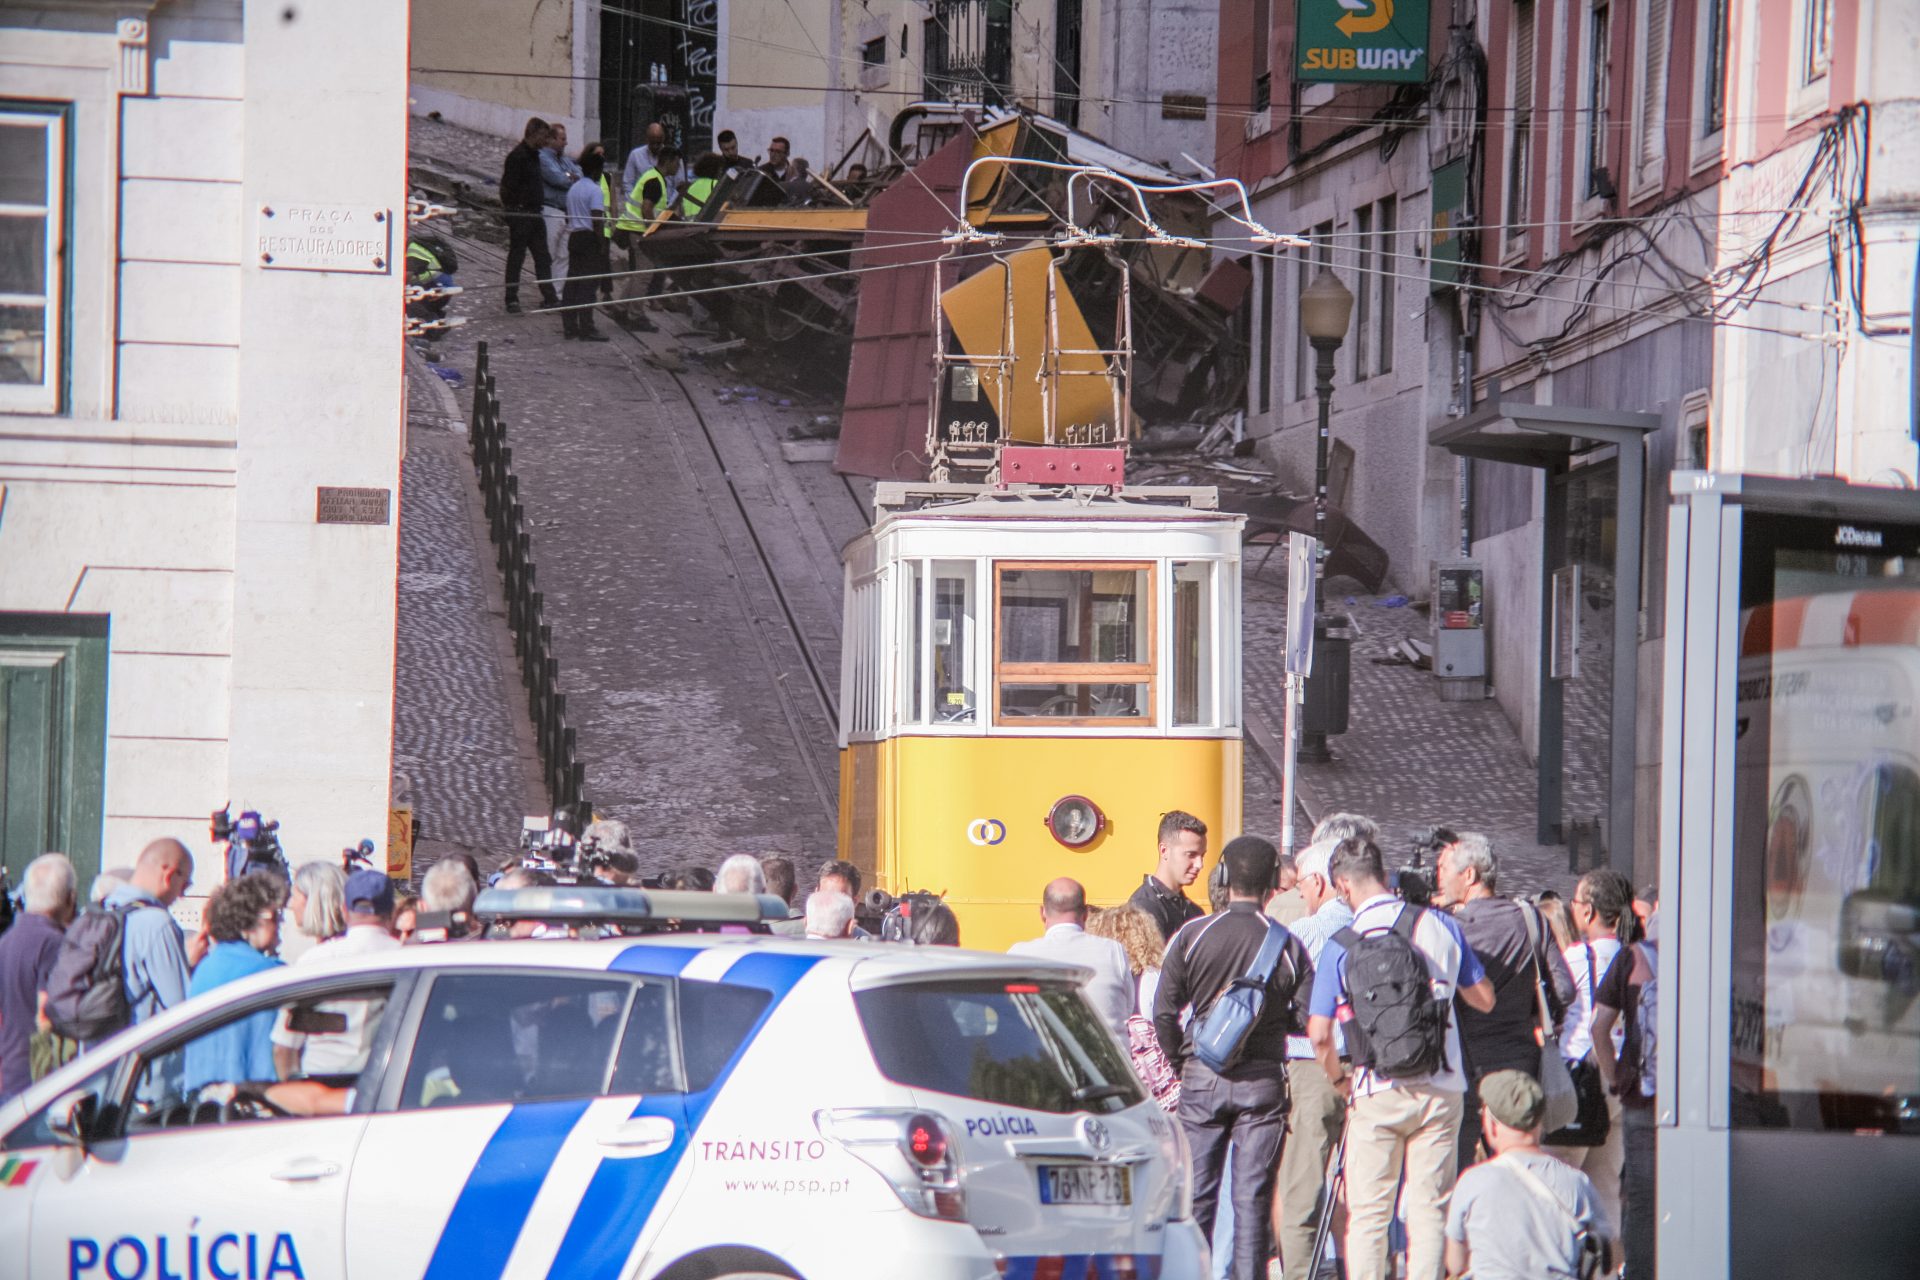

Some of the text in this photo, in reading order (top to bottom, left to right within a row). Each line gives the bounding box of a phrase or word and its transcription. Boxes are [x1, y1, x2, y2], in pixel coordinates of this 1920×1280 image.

[1302, 48, 1423, 70] SUBWAY
[289, 208, 354, 225] PRAÇA
[309, 226, 334, 234] DOS
[259, 236, 384, 257] RESTAURADORES
[1834, 525, 1883, 547] JCDecaux
[965, 1112, 1038, 1136] POLÍCIA
[724, 1178, 850, 1196] www.psp.pt
[67, 1216, 306, 1280] POLÍCIA
